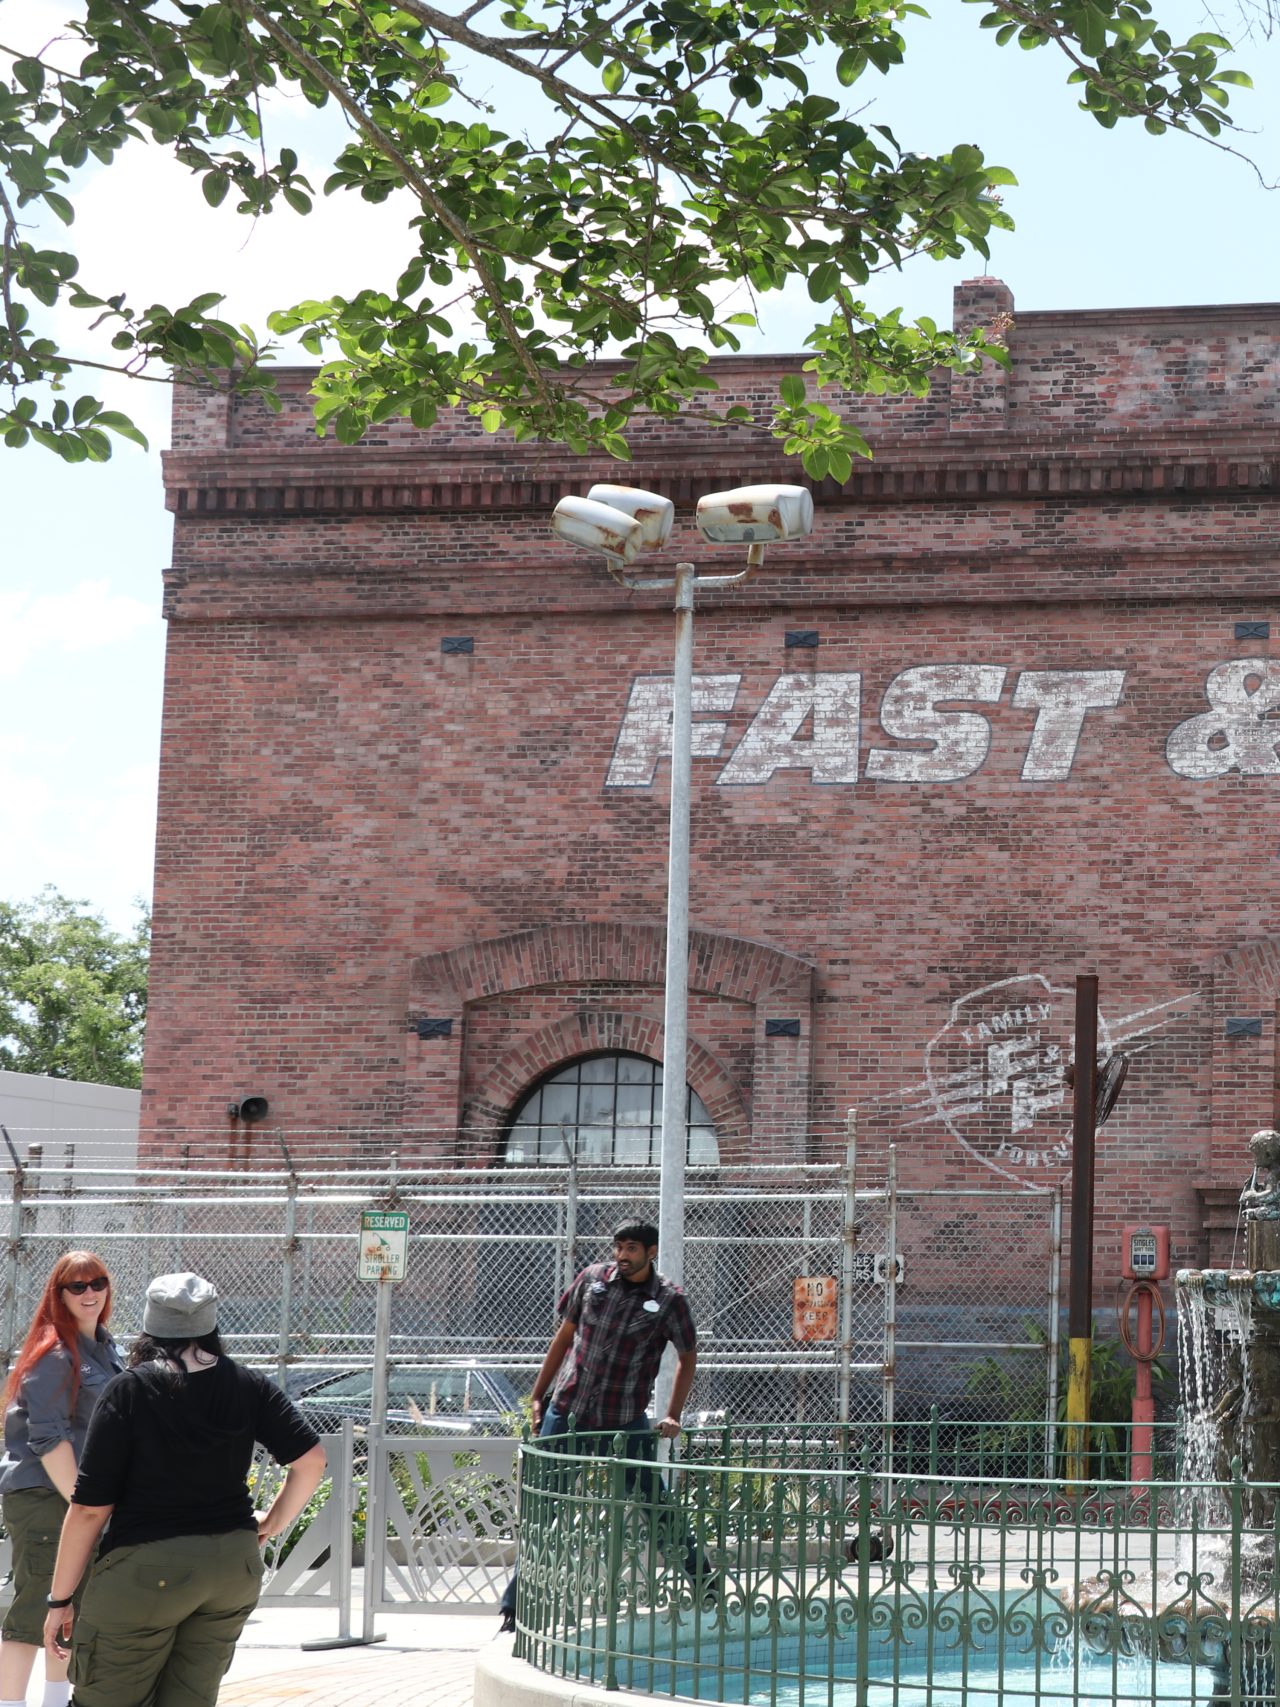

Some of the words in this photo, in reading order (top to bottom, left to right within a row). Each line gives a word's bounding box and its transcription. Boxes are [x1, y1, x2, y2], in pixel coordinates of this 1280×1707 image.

[604, 662, 1127, 788] FAST
[961, 1004, 1050, 1046] FAMILY
[364, 1216, 405, 1228] RESERVED
[1133, 1239, 1155, 1247] SINGLES
[365, 1253, 400, 1264] STROLLER
[366, 1265, 398, 1275] PARKING
[807, 1282, 824, 1297] NO
